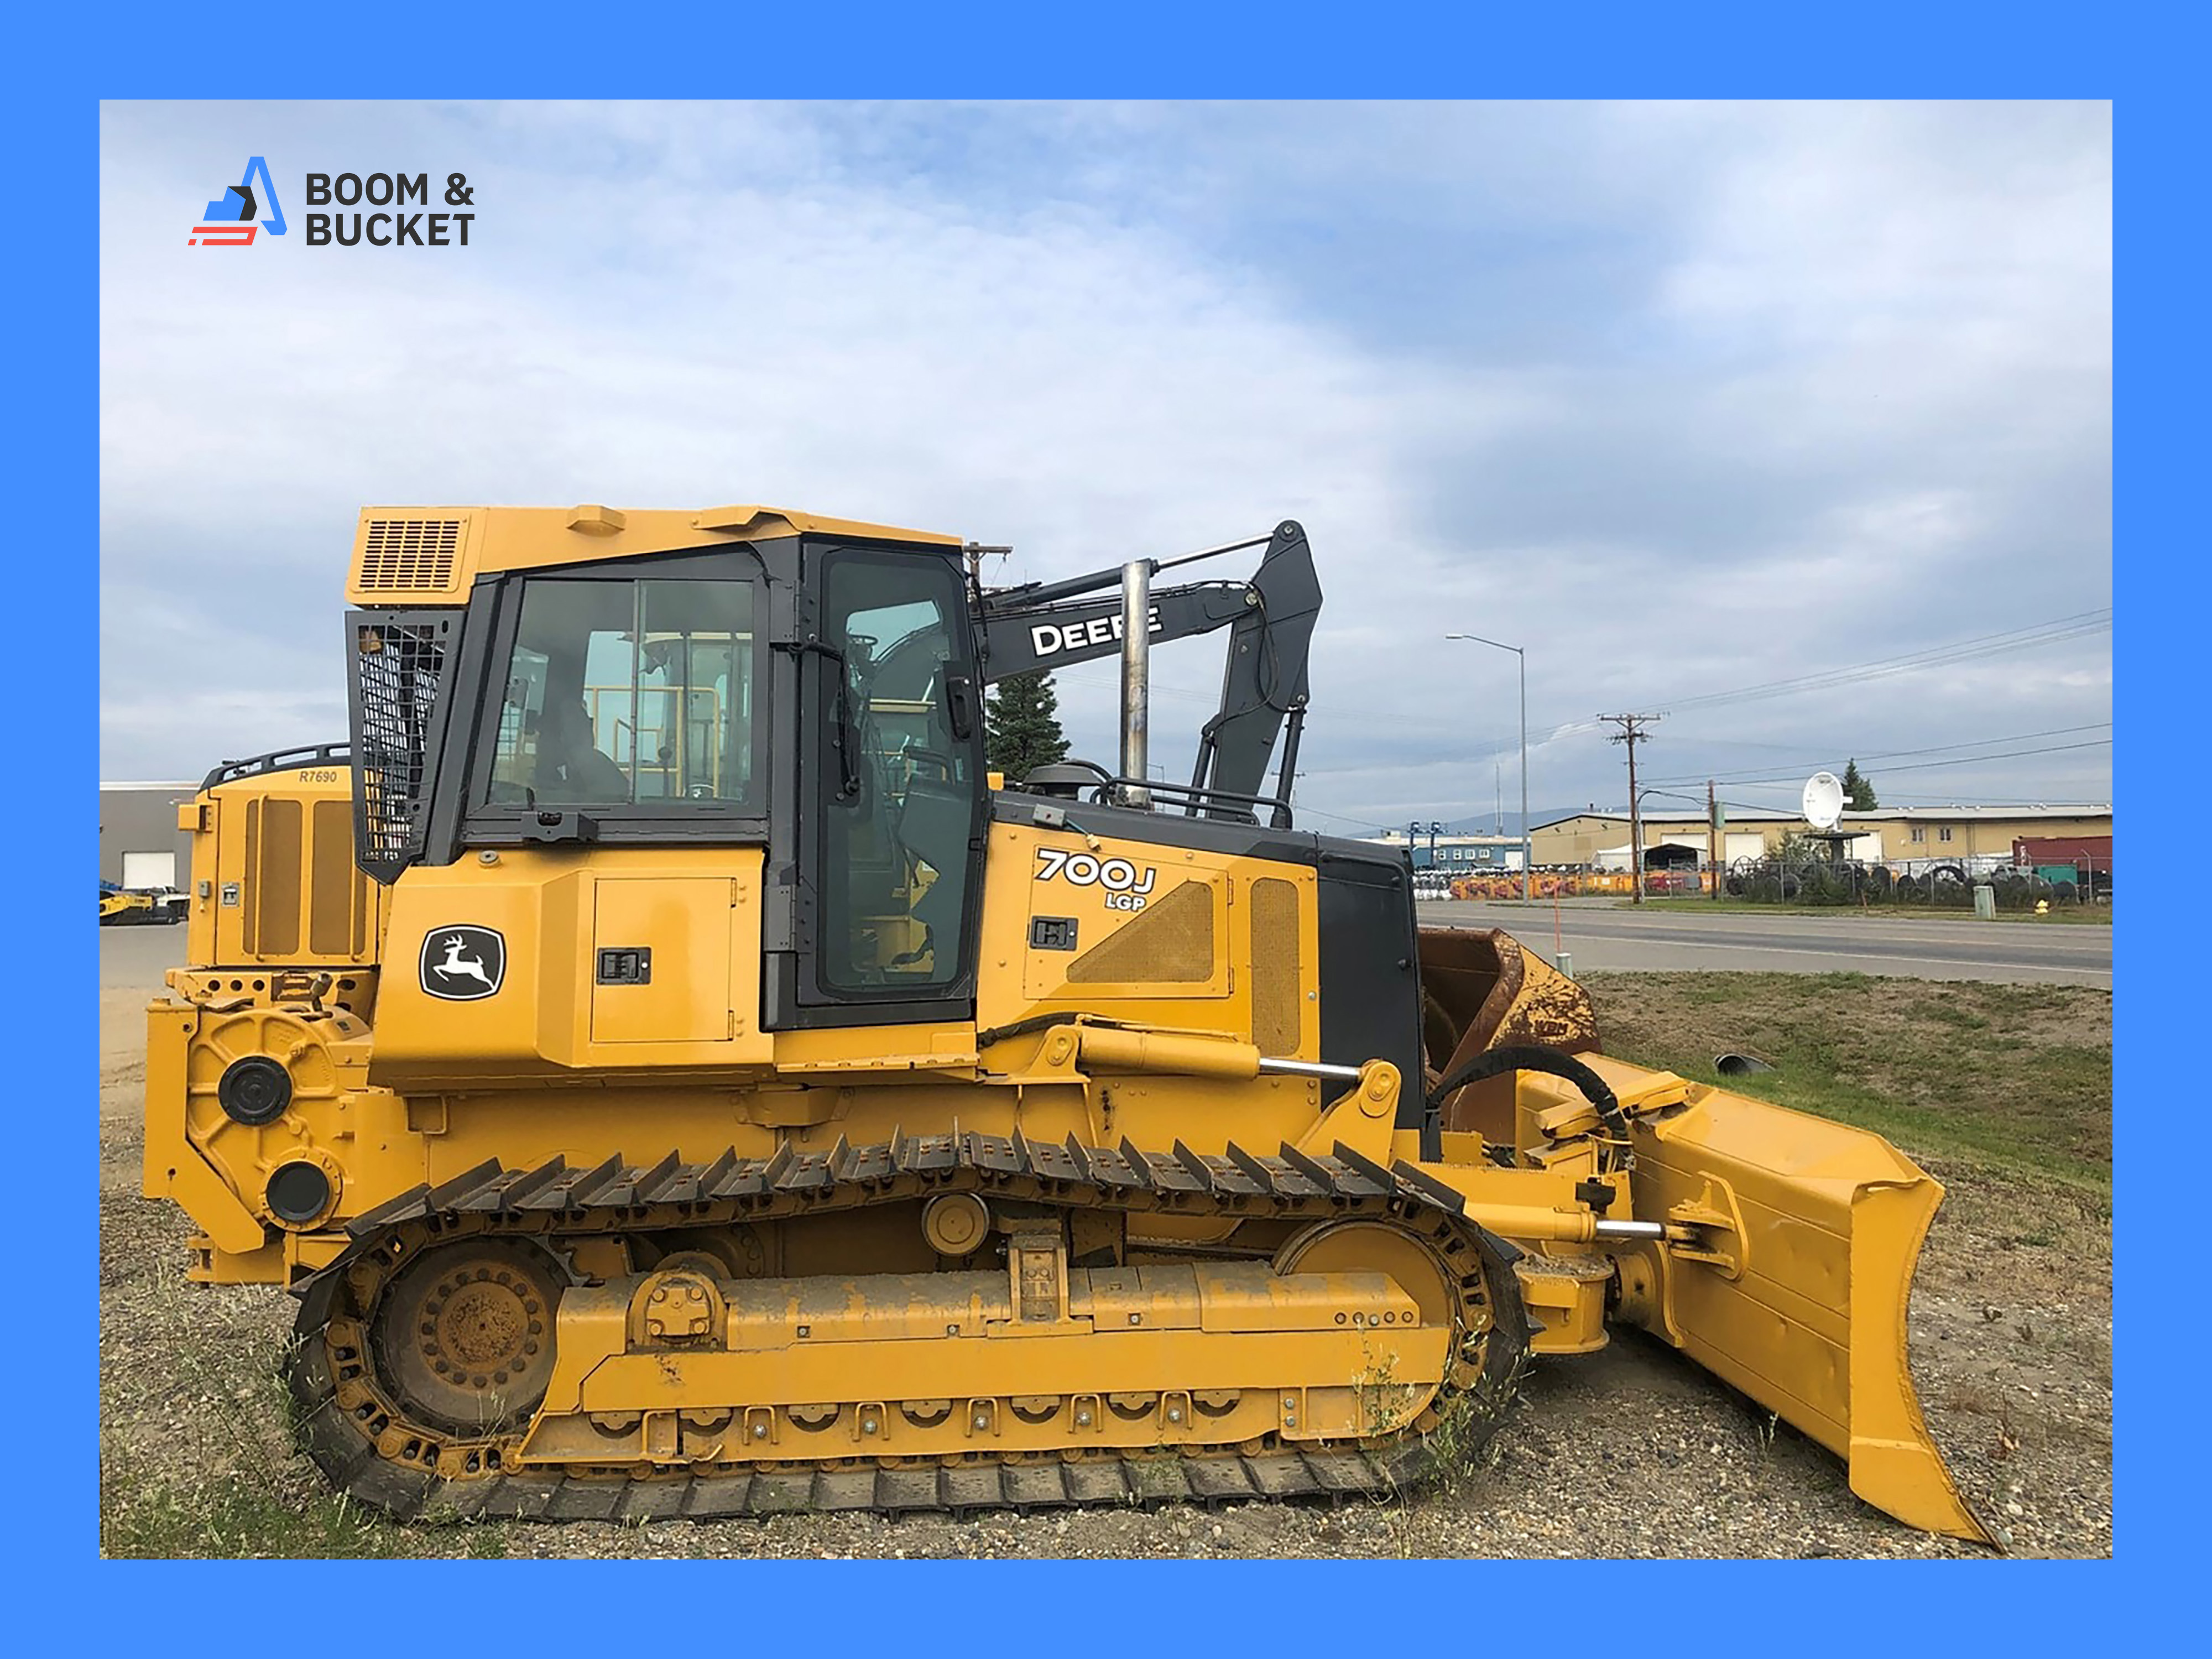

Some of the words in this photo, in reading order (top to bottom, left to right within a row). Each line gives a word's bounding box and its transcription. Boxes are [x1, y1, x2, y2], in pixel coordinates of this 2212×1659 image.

[299, 771, 337, 782] R7690
[1035, 848, 1156, 895] 700J
[1105, 892, 1146, 912] LGP
